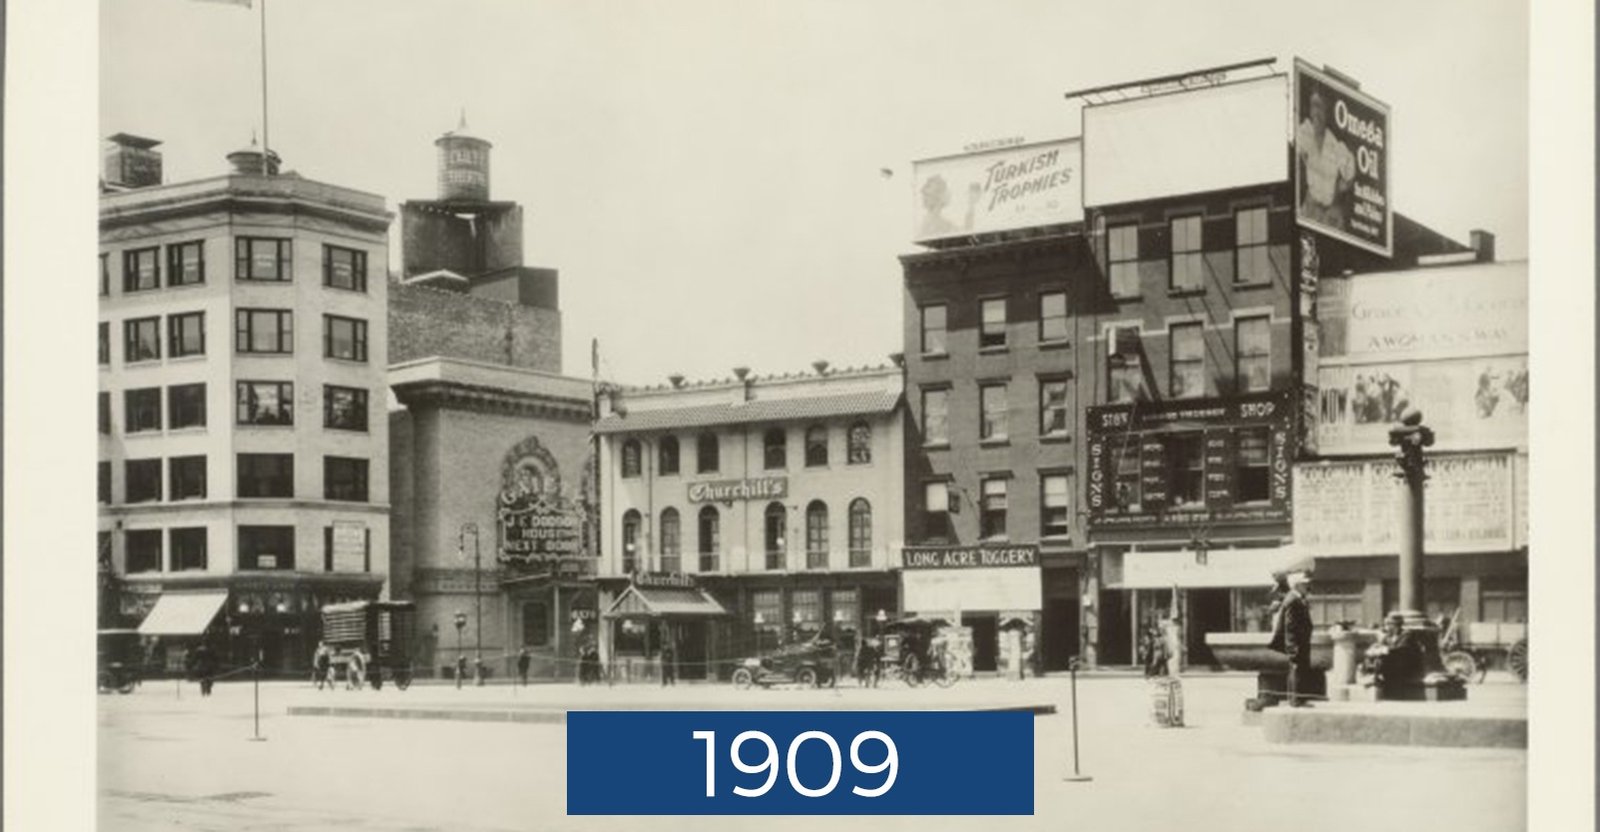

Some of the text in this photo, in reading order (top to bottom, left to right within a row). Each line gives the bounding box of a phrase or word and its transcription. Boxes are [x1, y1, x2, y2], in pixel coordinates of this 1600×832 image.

[1334, 99, 1384, 149] Omega
[984, 149, 1060, 192] TURKISH
[1356, 145, 1379, 180] Oil
[988, 167, 1074, 213] TROPHIES
[1240, 402, 1275, 419] SHOP
[1320, 387, 1348, 425] NOW
[690, 480, 784, 502] Churchill's
[905, 548, 1035, 567] LONG ACRE TOGGERY
